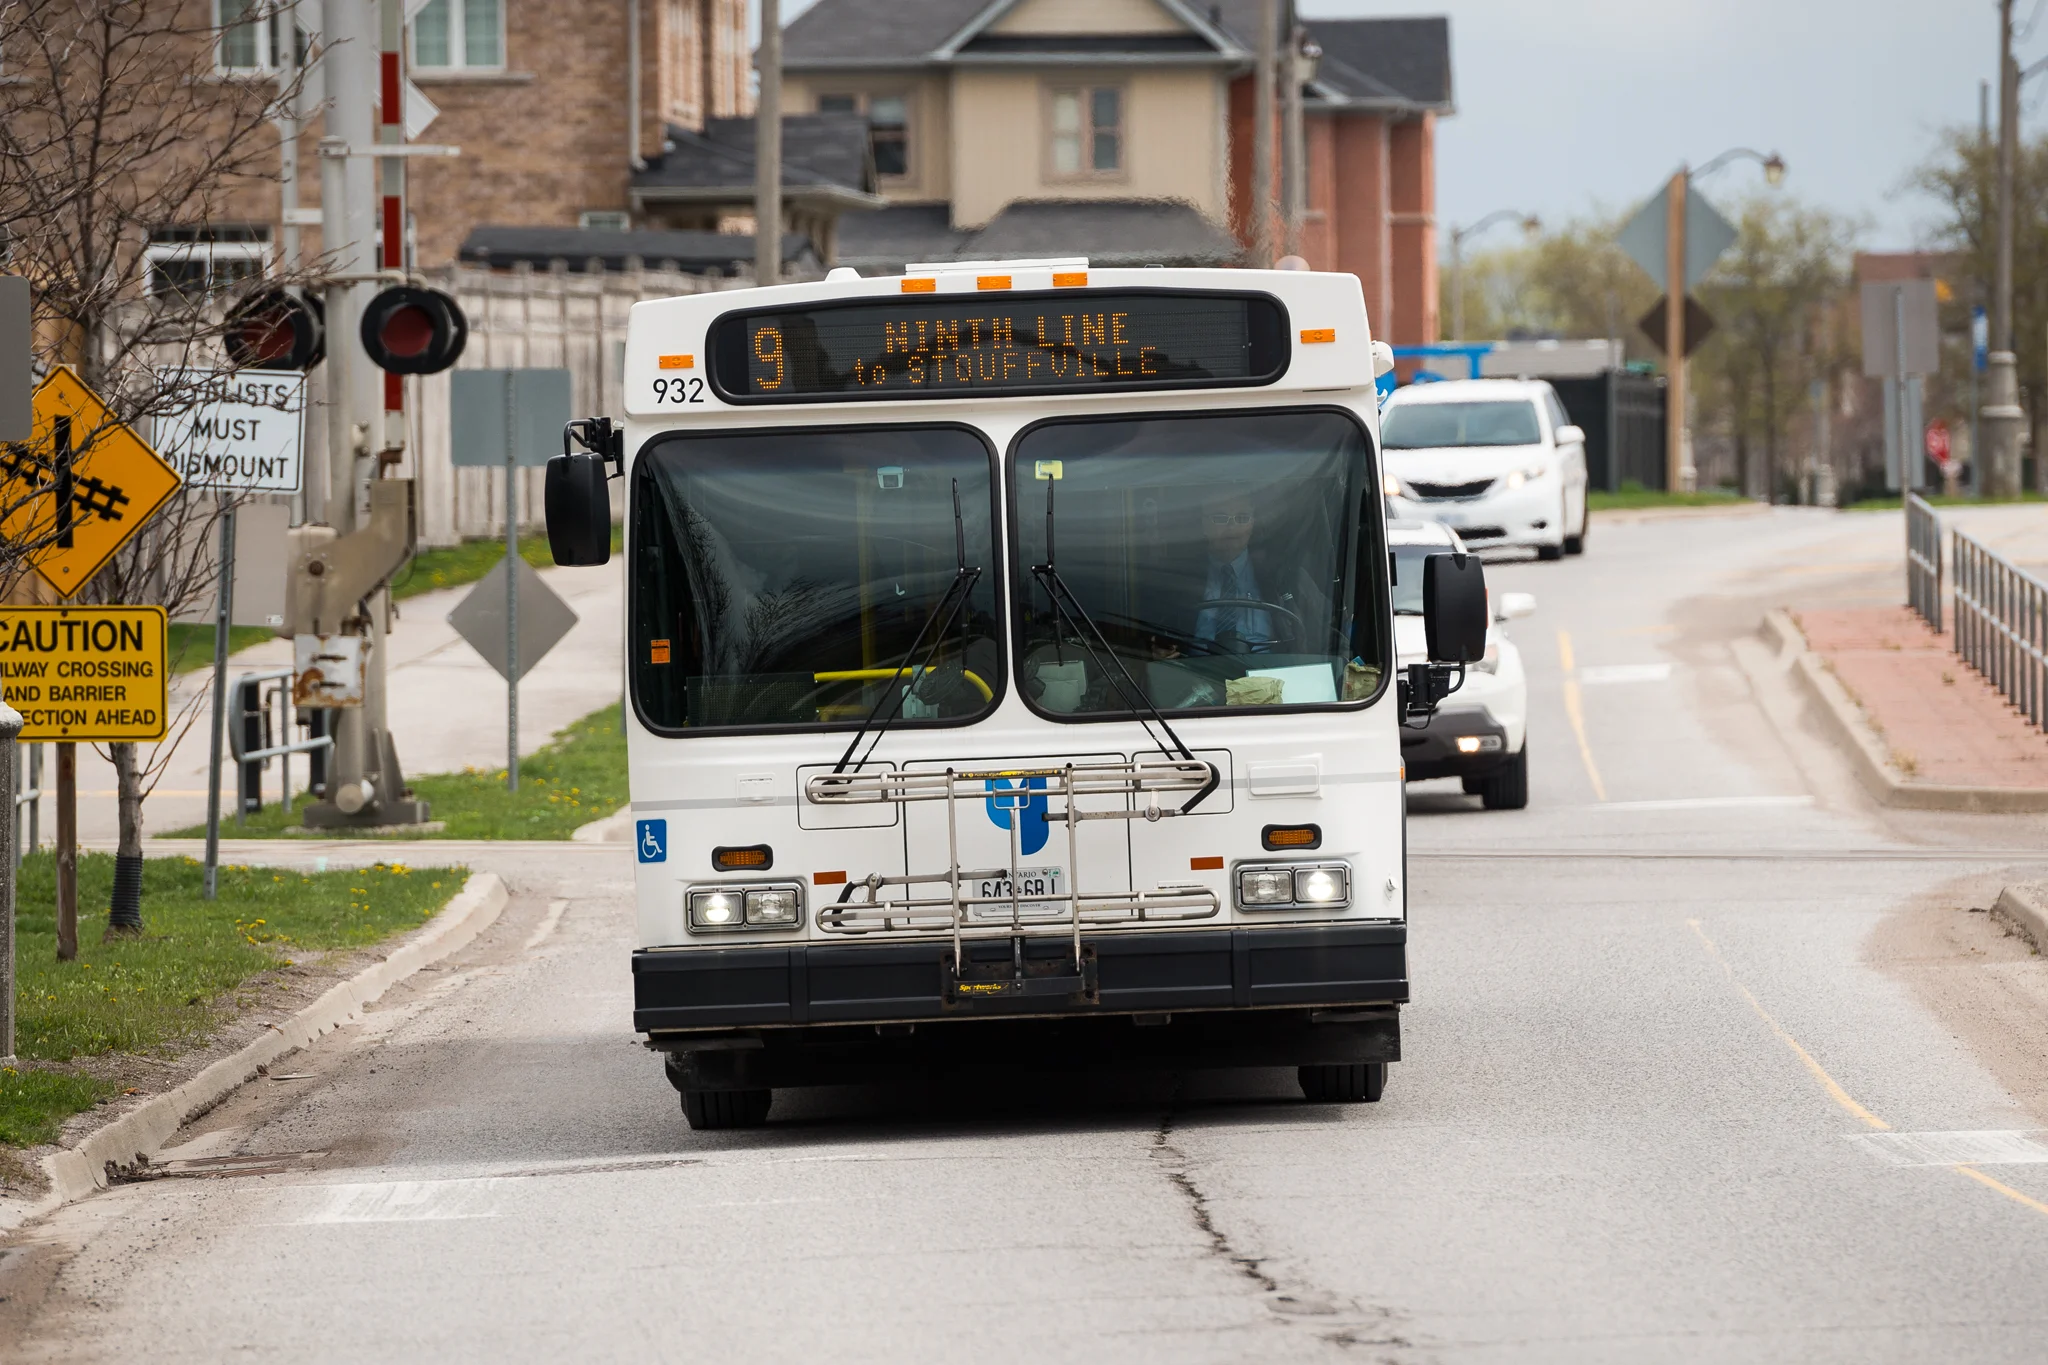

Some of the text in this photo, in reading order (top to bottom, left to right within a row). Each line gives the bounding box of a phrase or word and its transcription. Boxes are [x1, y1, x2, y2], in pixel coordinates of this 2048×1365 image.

[884, 313, 1130, 353] NINTH LINE
[754, 327, 784, 389] 9
[854, 346, 1158, 385] to STOUFFVILLE
[652, 377, 705, 404] 932
[193, 417, 262, 441] MUST
[0, 661, 154, 678] ILWAY CROSSING
[2, 685, 127, 702] AND BARRIER
[15, 709, 157, 726] ECTION AHEAD
